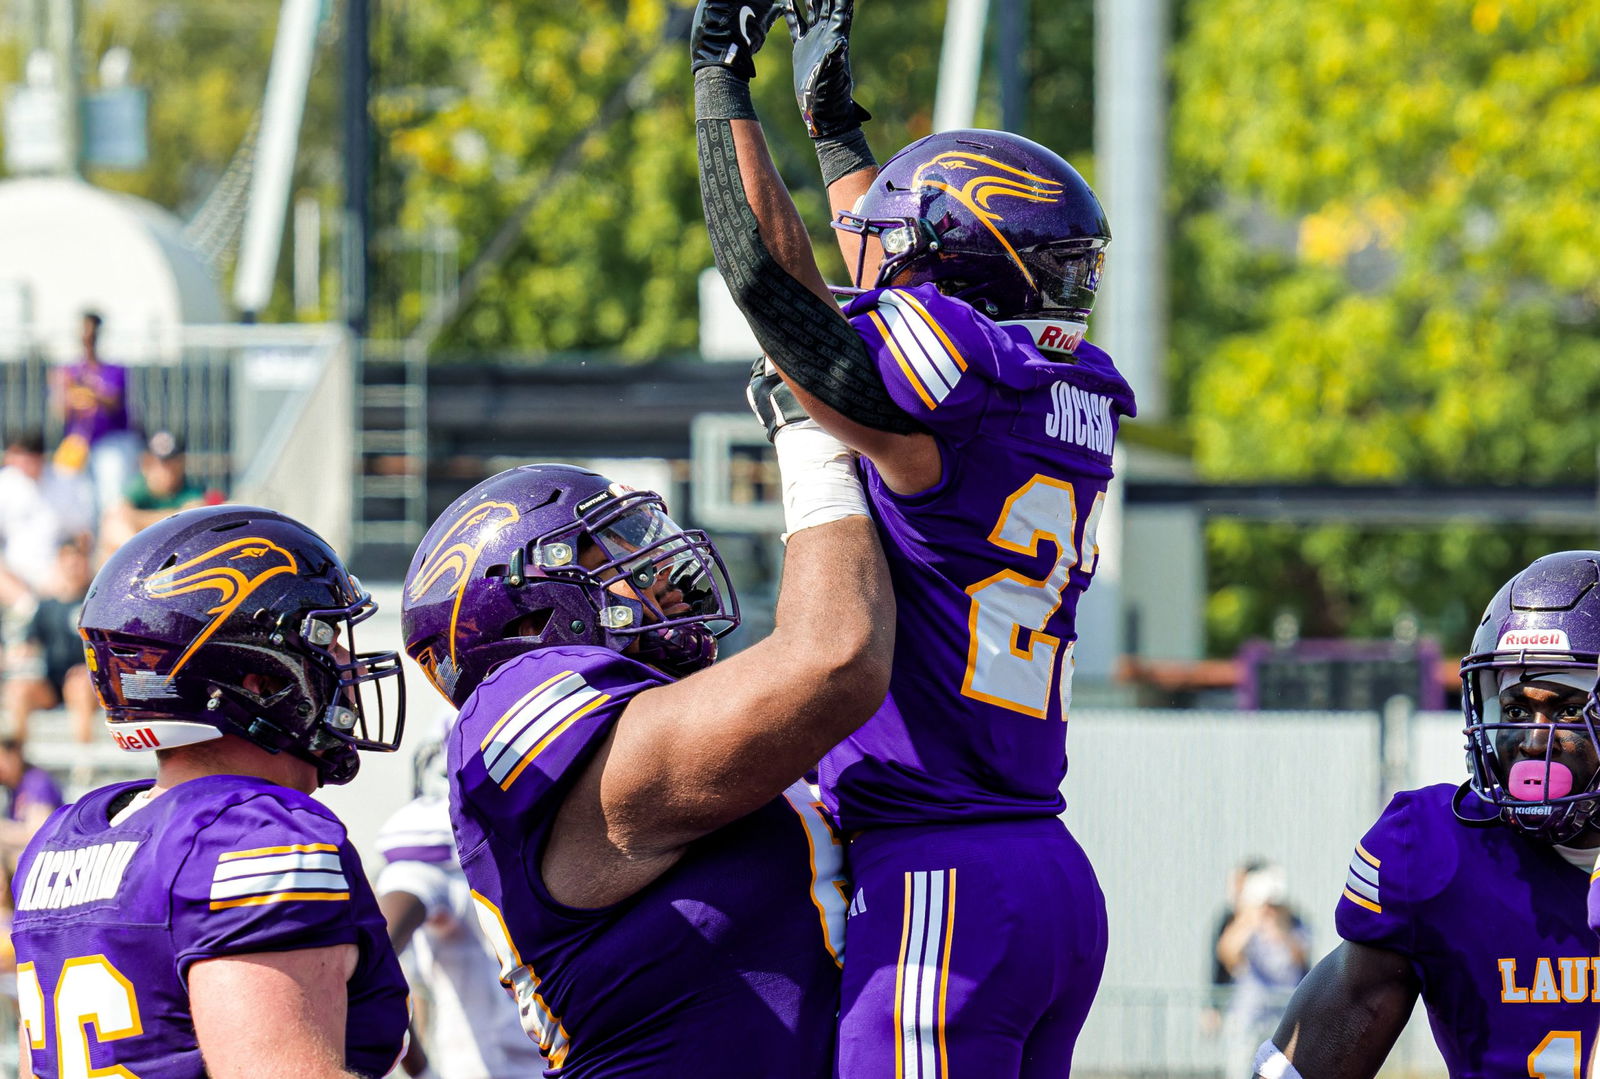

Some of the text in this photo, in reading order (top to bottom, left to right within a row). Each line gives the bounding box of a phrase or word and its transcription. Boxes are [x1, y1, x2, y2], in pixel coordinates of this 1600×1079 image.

[1037, 325, 1081, 351] Rid
[961, 473, 1104, 720] 2
[1506, 634, 1560, 645] Riddell
[1515, 805, 1552, 815] Riddell
